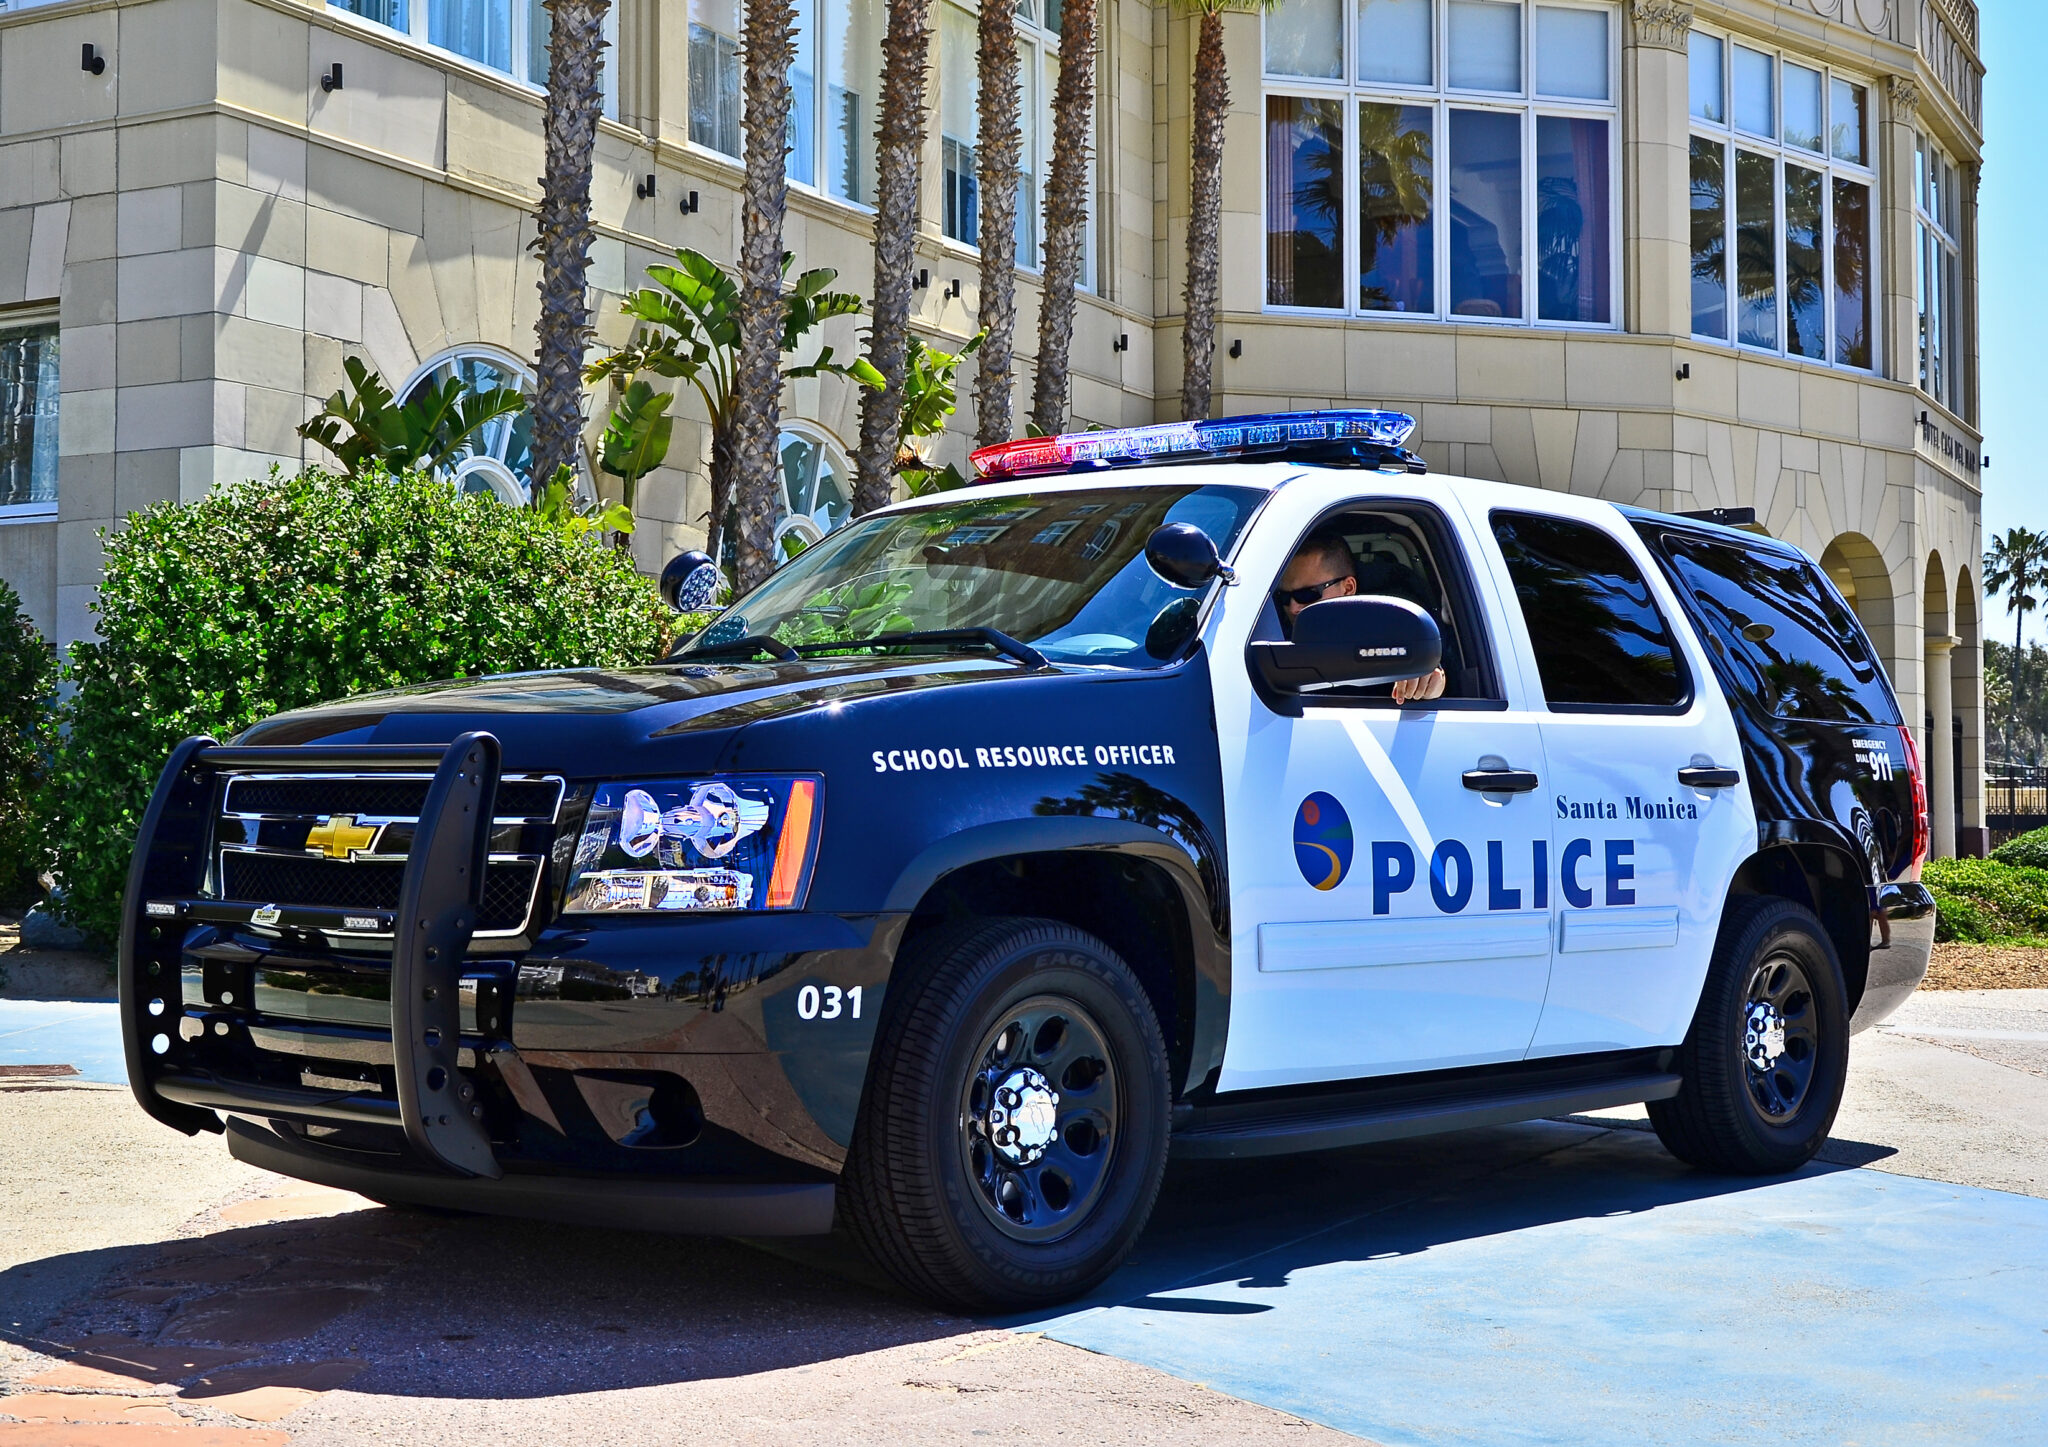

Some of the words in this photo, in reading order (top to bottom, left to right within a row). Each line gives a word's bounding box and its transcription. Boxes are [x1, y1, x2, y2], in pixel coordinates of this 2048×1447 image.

[1941, 431, 1954, 459] CASA
[1965, 447, 1976, 474] MAR
[871, 748, 970, 773] SCHOOL
[975, 745, 1089, 768] RESOURCE
[1094, 744, 1176, 766] OFFICER
[1851, 738, 1887, 750] EMERGENCY
[1855, 753, 1870, 763] DIAL
[1869, 751, 1894, 781] 911
[1556, 794, 1618, 820] Santa
[1625, 796, 1698, 820] Monica
[1371, 838, 1636, 915] POLICE
[1033, 951, 1122, 987] EAGLE
[797, 984, 863, 1020] 031
